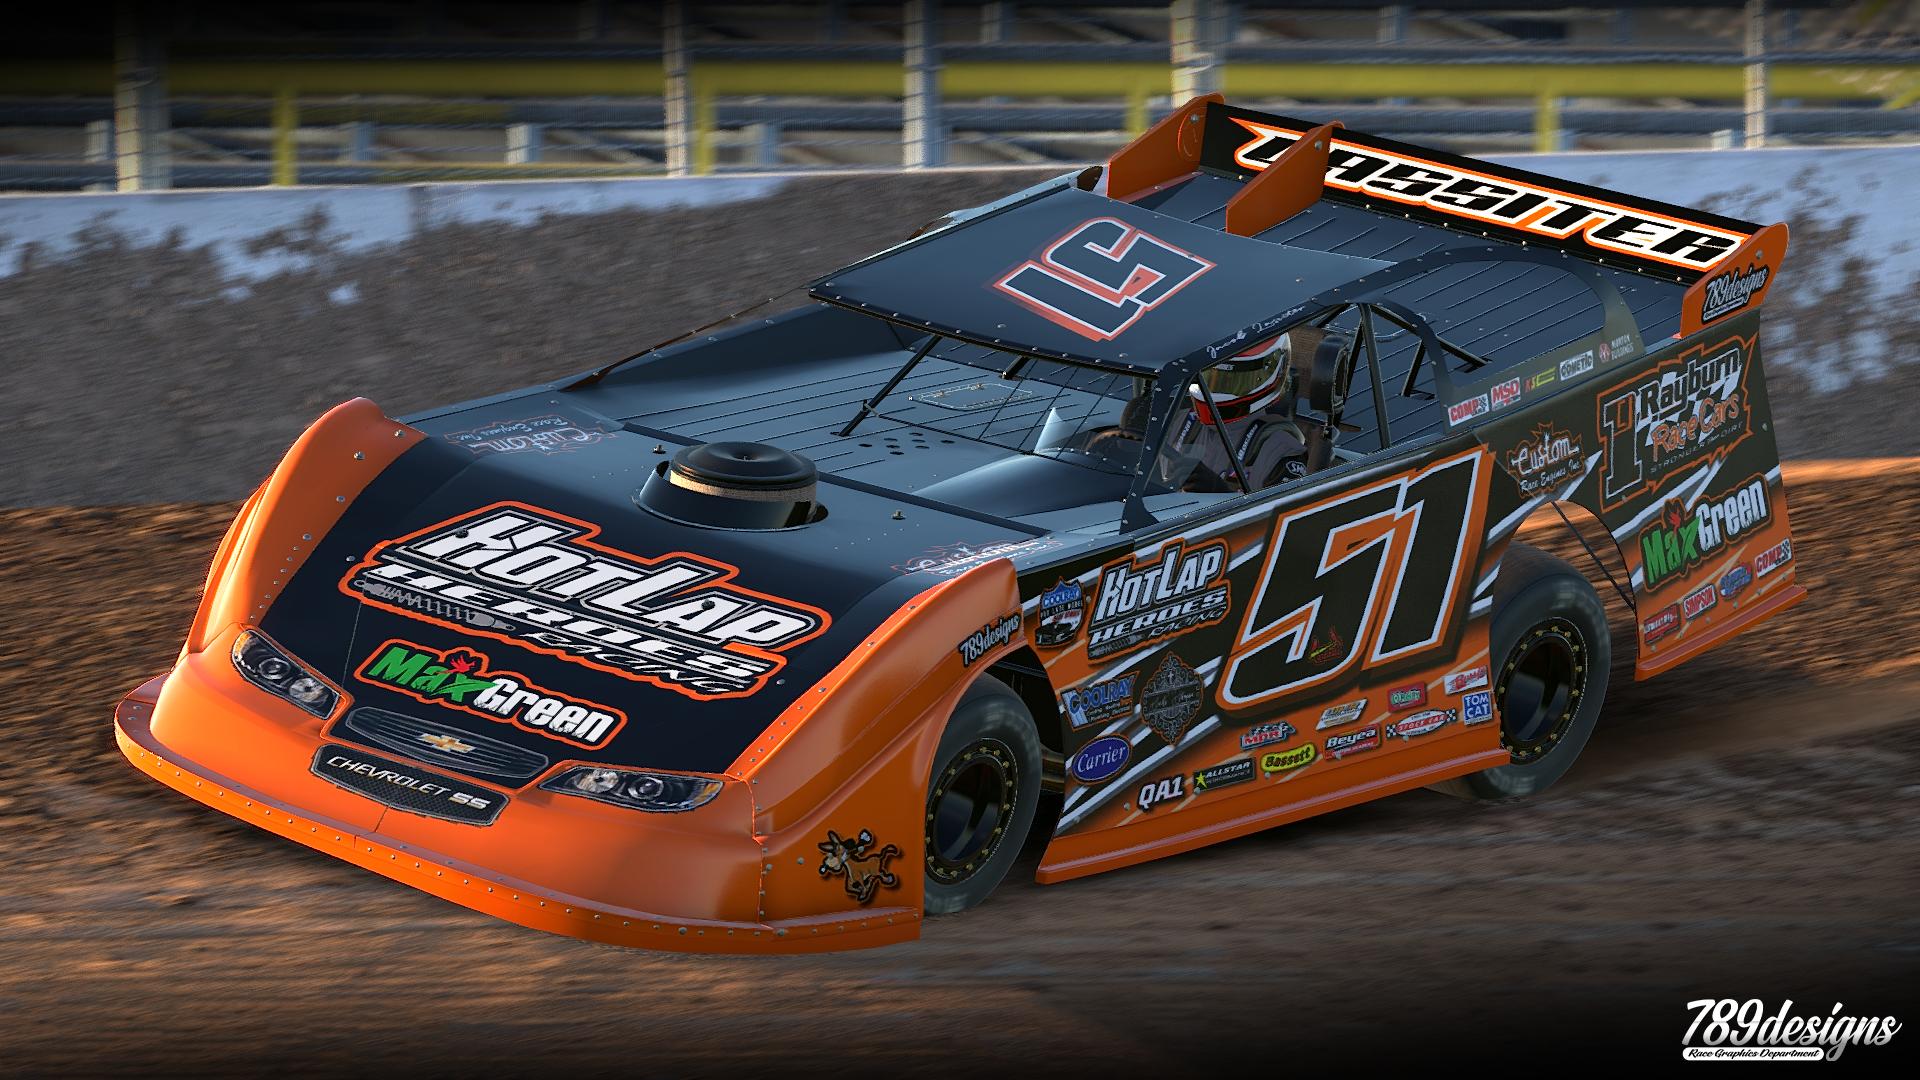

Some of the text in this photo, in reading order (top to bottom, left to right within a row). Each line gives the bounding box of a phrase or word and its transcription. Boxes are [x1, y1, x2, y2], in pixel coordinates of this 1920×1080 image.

[997, 216, 1213, 339] 51
[1492, 380, 1519, 404] MSD
[1638, 348, 1741, 423] Rayburn
[1652, 394, 1740, 462] Race Cars
[1222, 449, 1485, 706] 51
[367, 564, 770, 683] HEROES
[960, 615, 1019, 665] 789designs
[1089, 590, 1226, 646] HEROES
[520, 630, 731, 693] RACING
[369, 646, 614, 743] MaxGreen
[1070, 675, 1136, 714] COOLRAY
[1465, 694, 1489, 707] TOM
[1466, 703, 1489, 718] CAT
[1077, 746, 1126, 773] Carrier
[1264, 746, 1311, 768] Bassett
[1326, 729, 1376, 750] Beyea
[327, 756, 492, 810] CHEVROLET SS
[1138, 776, 1184, 809] QA1
[1206, 761, 1250, 778] ALLSTAR
